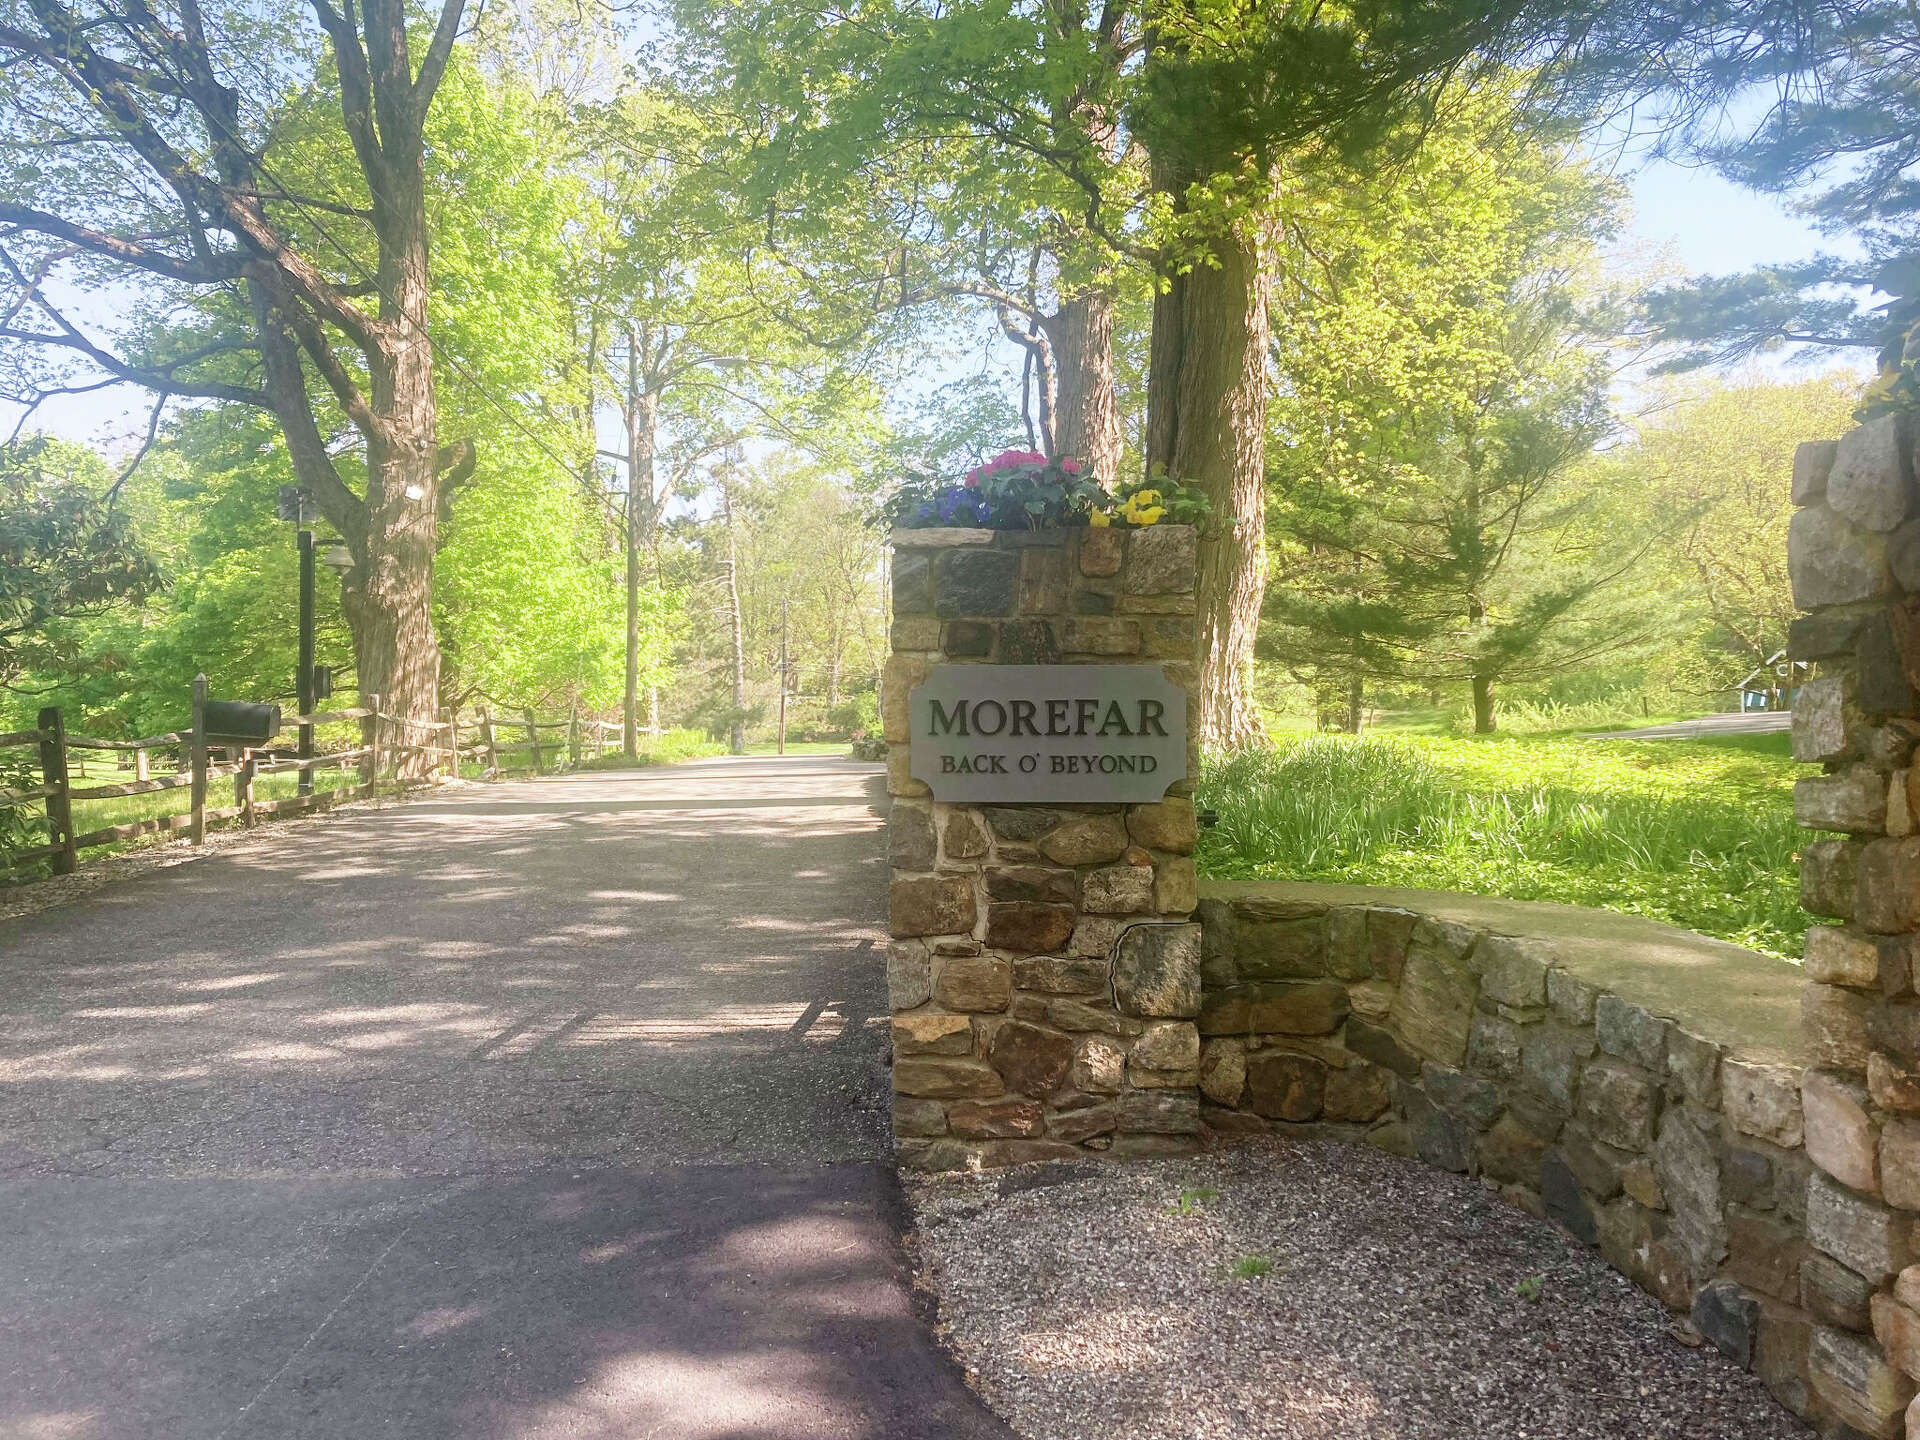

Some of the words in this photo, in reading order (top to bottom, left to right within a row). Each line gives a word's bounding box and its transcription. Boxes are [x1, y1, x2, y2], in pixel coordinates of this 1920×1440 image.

[928, 699, 1169, 738] MOREFAR
[940, 755, 1009, 775] BACK
[1049, 755, 1158, 775] BEYOND
